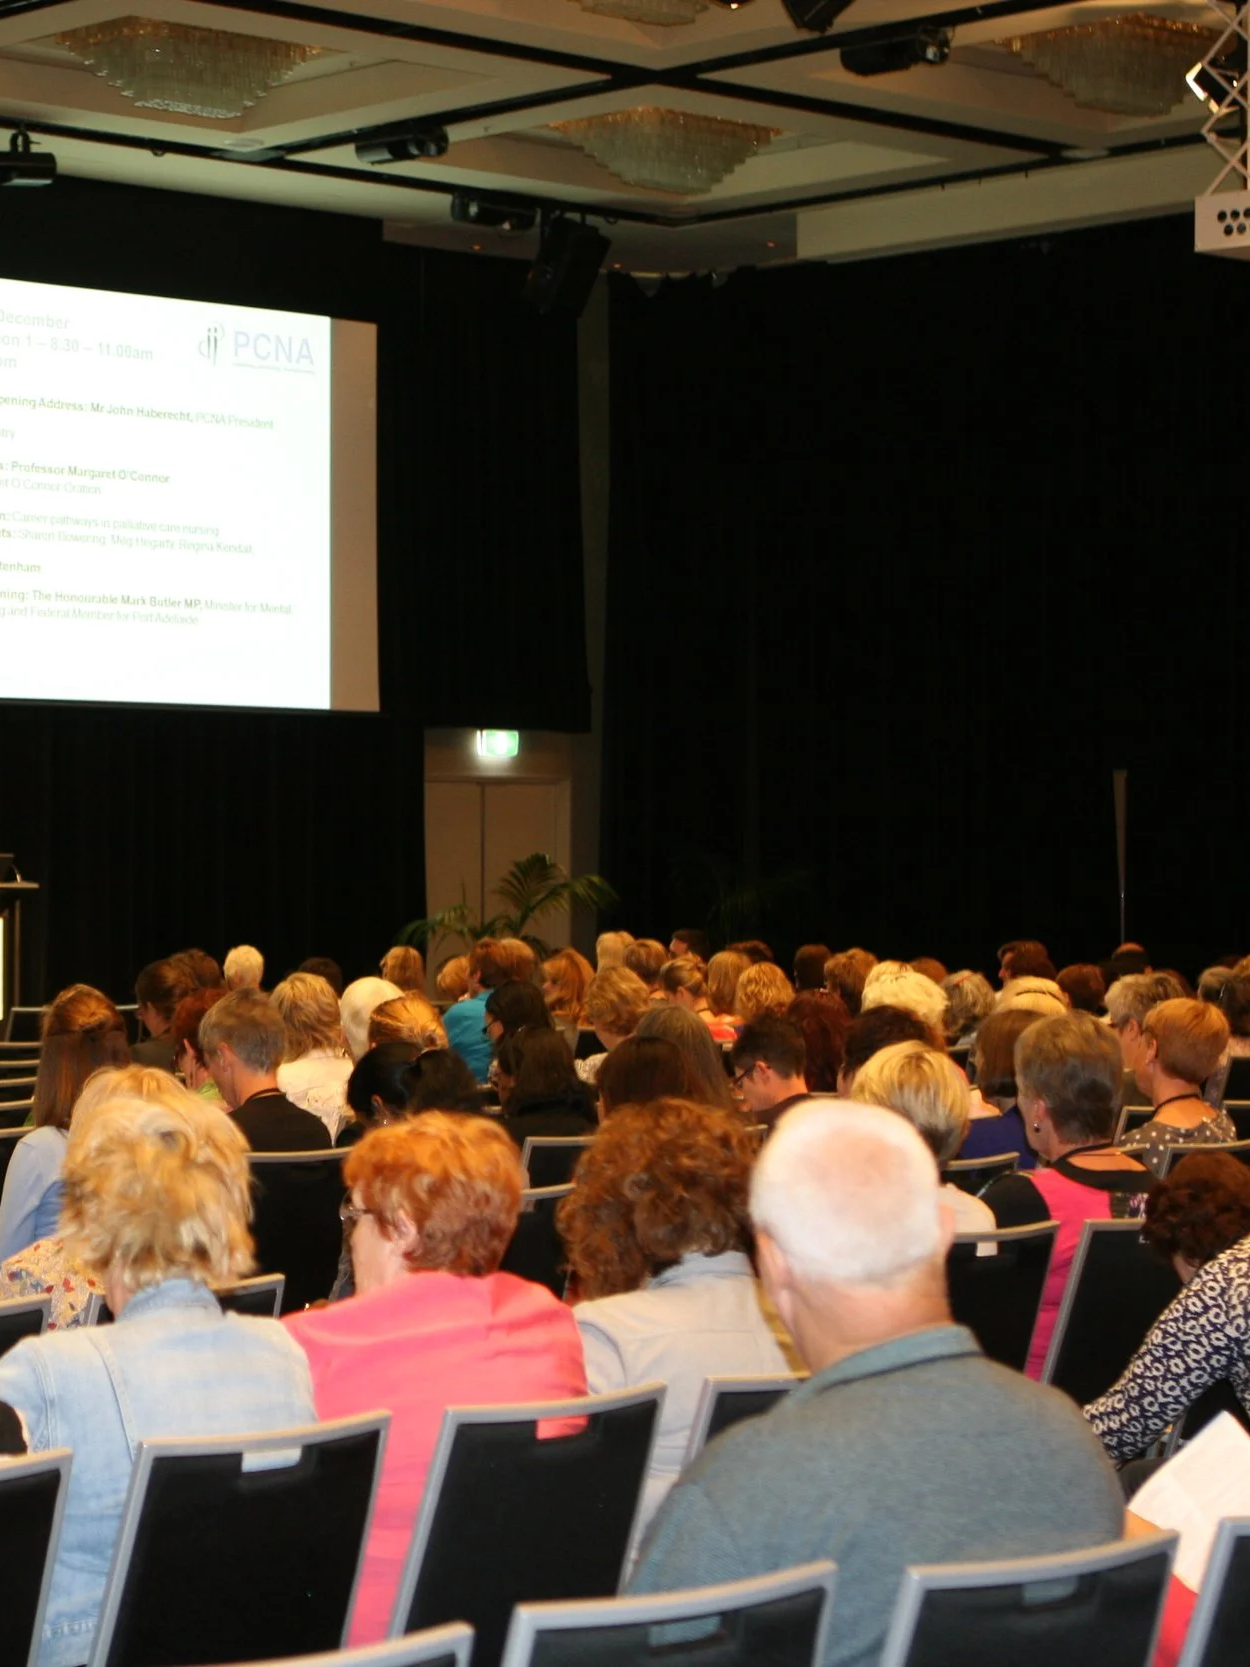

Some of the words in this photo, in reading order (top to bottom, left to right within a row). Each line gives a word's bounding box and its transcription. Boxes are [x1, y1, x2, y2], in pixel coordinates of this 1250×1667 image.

[26, 334, 32, 348] 1
[50, 336, 79, 353] 8.30
[98, 341, 153, 362] 11.00am
[234, 330, 315, 366] PCNA
[38, 397, 88, 413] Address:
[90, 401, 105, 413] Mr
[106, 403, 134, 417] John
[11, 461, 66, 475] Professor
[68, 465, 116, 480] Margaret
[118, 468, 171, 484] O'Connor
[31, 588, 52, 602] The
[54, 590, 118, 606] Honourable
[120, 592, 147, 606] Mark
[149, 594, 182, 609] Butler
